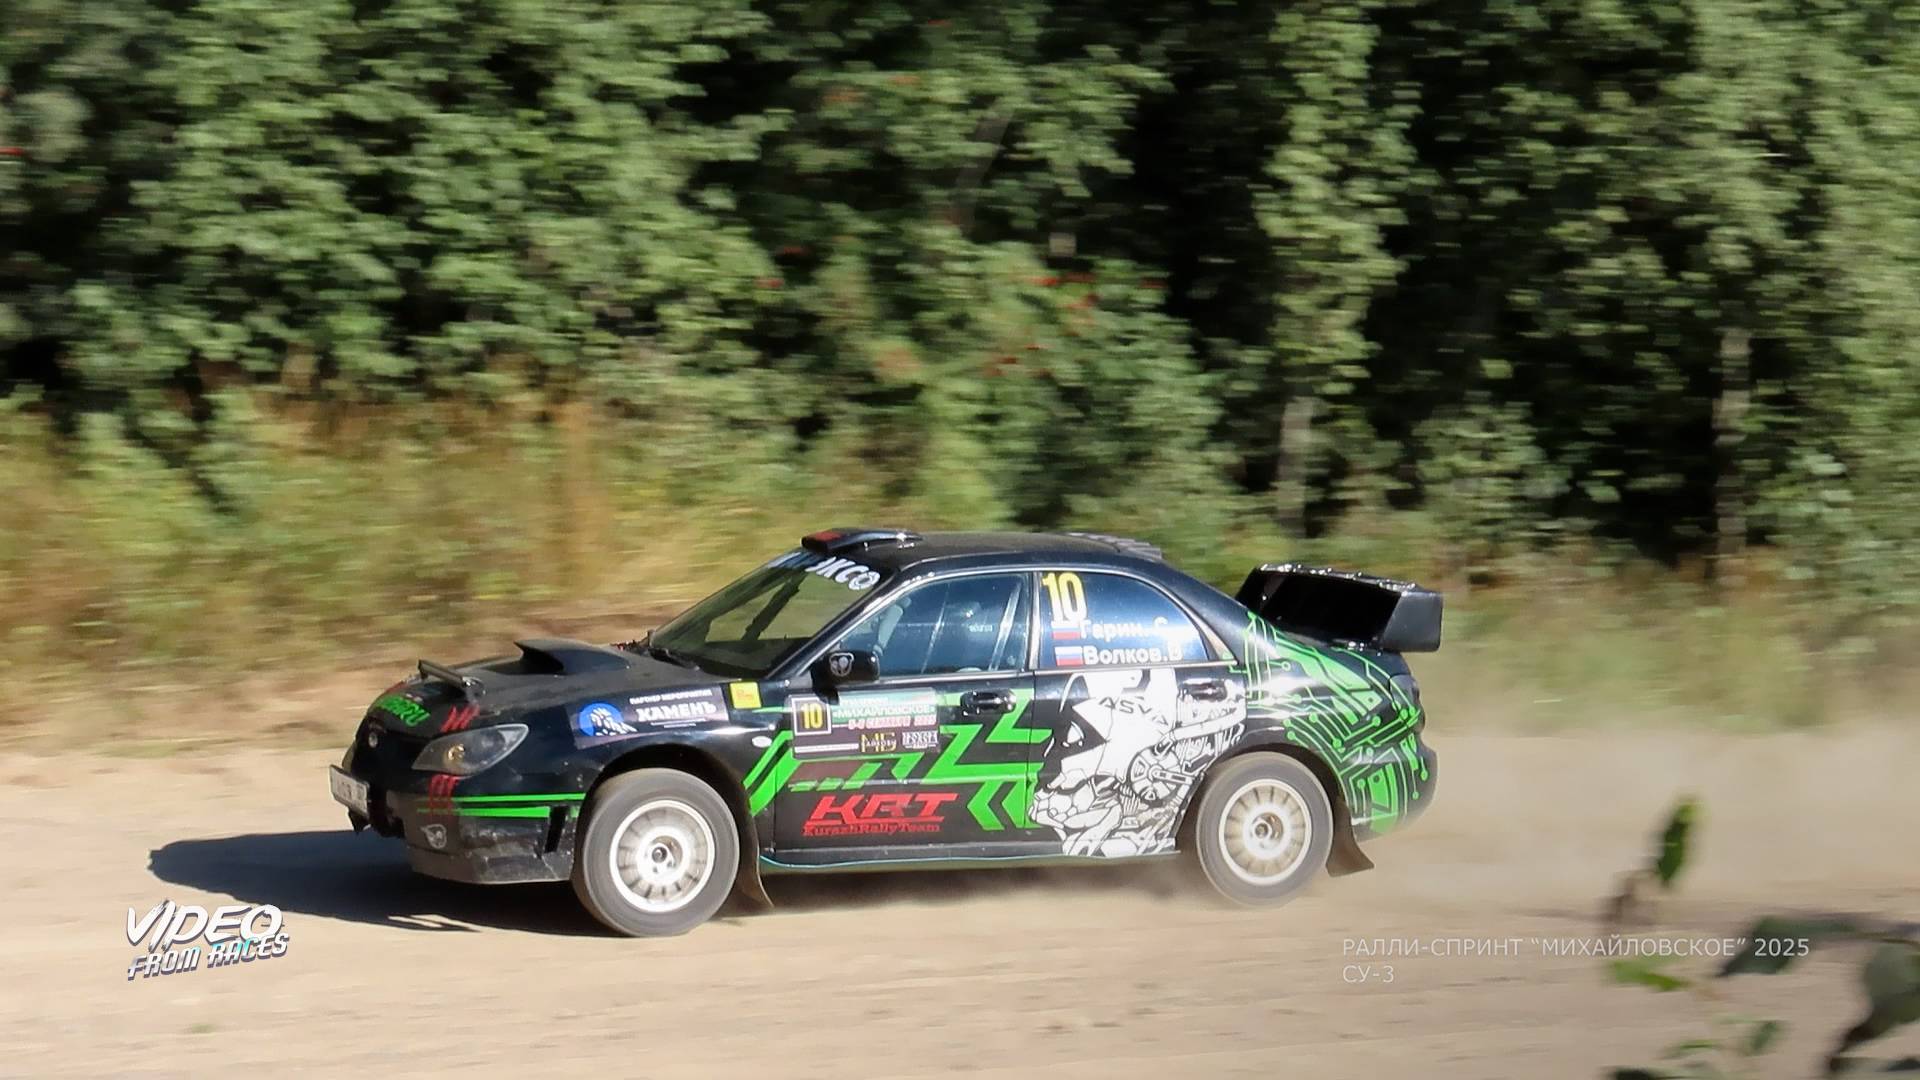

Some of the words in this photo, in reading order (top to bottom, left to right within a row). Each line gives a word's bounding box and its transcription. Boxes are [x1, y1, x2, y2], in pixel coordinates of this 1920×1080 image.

[1042, 572, 1088, 622] 10
[801, 702, 823, 729] 10
[806, 793, 959, 824] KRT
